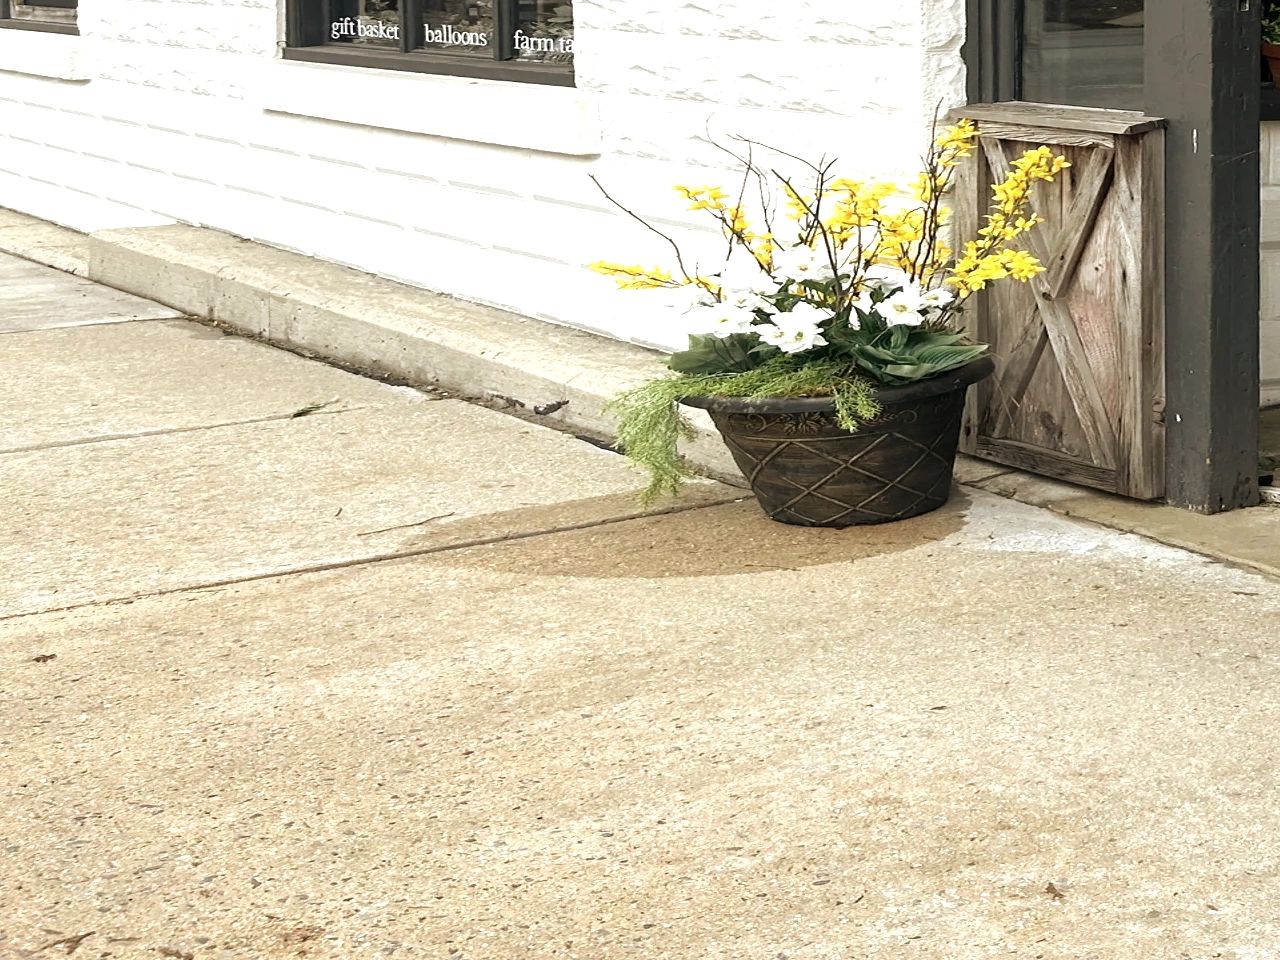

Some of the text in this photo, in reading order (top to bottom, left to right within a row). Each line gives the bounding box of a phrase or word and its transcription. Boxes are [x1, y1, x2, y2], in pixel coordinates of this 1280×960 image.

[331, 17, 400, 40] gift basket
[424, 23, 488, 46] balloons
[513, 29, 554, 52] farm
